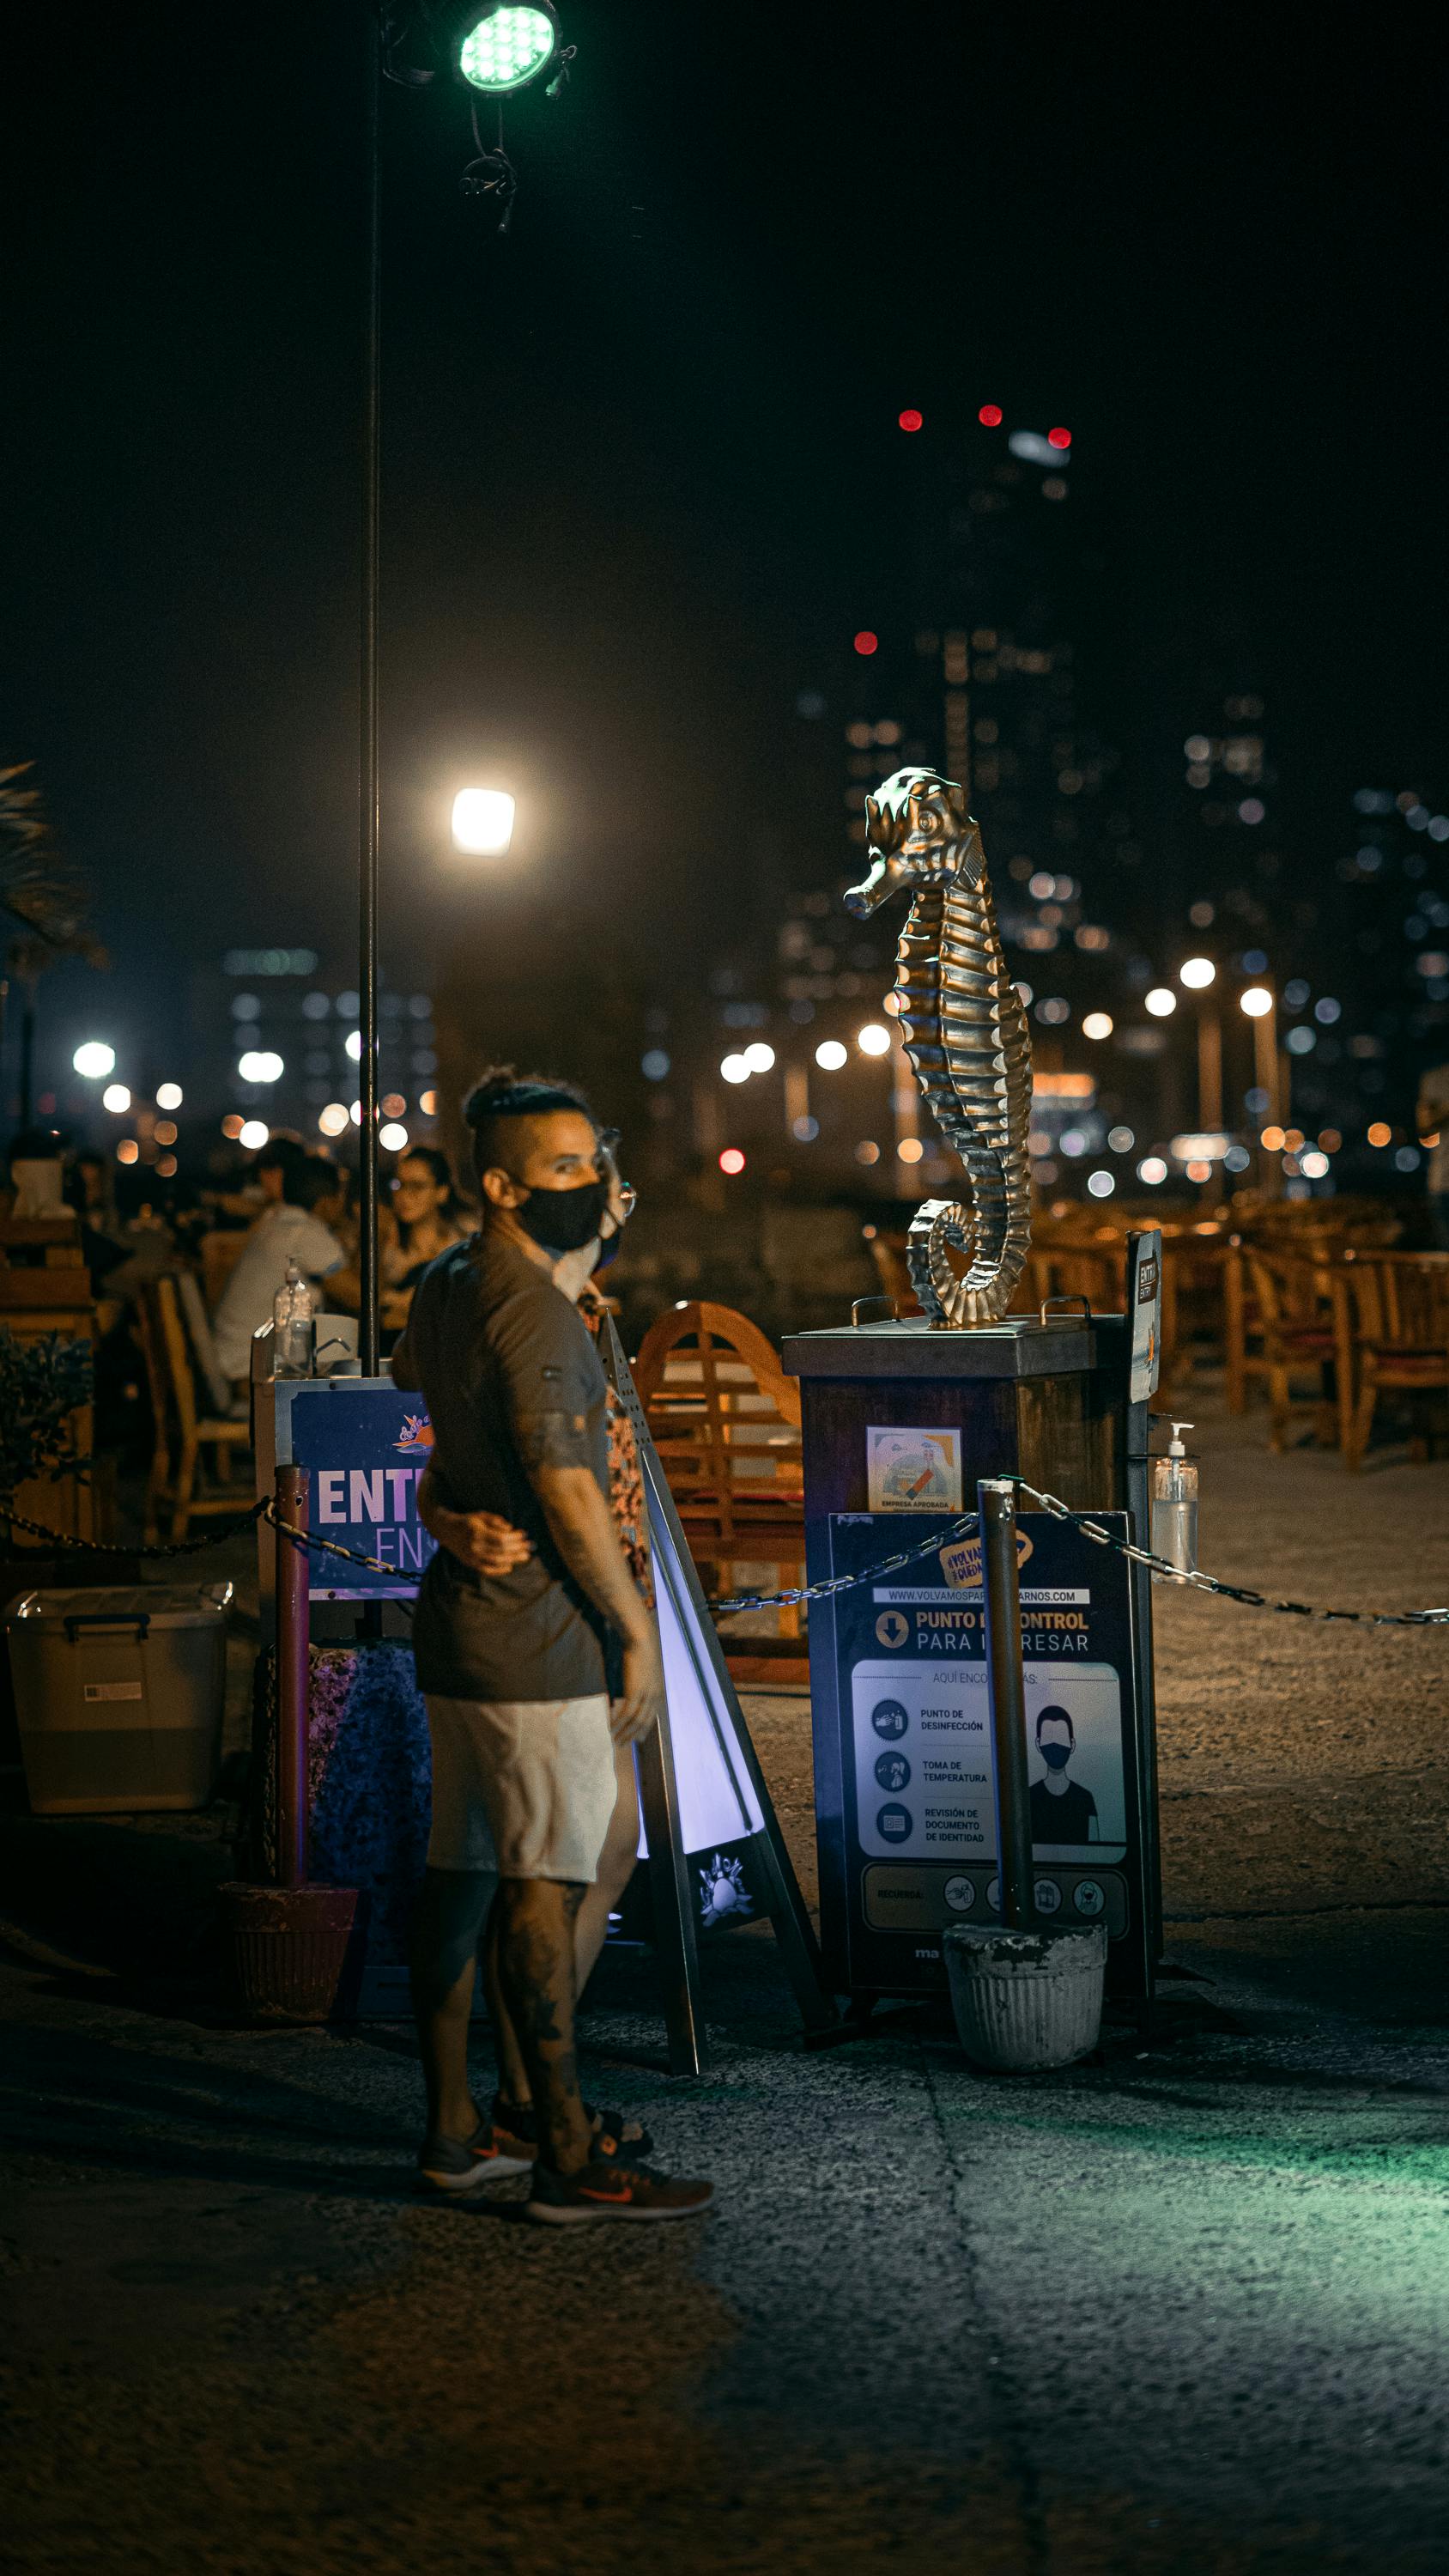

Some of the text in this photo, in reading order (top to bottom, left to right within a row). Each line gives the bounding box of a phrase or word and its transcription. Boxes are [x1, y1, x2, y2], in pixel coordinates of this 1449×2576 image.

[916, 1611, 976, 1629] PUNTO
[1020, 1613, 1089, 1630] ONTROL
[918, 1633, 971, 1649] PARA
[933, 1669, 957, 1684] AQUÍ
[920, 1709, 963, 1718] PUNTO DE
[921, 1721, 983, 1731] DESINFECCIÓN
[923, 1761, 961, 1770] TOMA DE
[924, 1773, 987, 1783] TEMPERATURA
[925, 1807, 978, 1819] REVISIÓN DE
[925, 1820, 979, 1831] DOCUMENTO
[925, 1832, 985, 1843] DE IDENTIDAD
